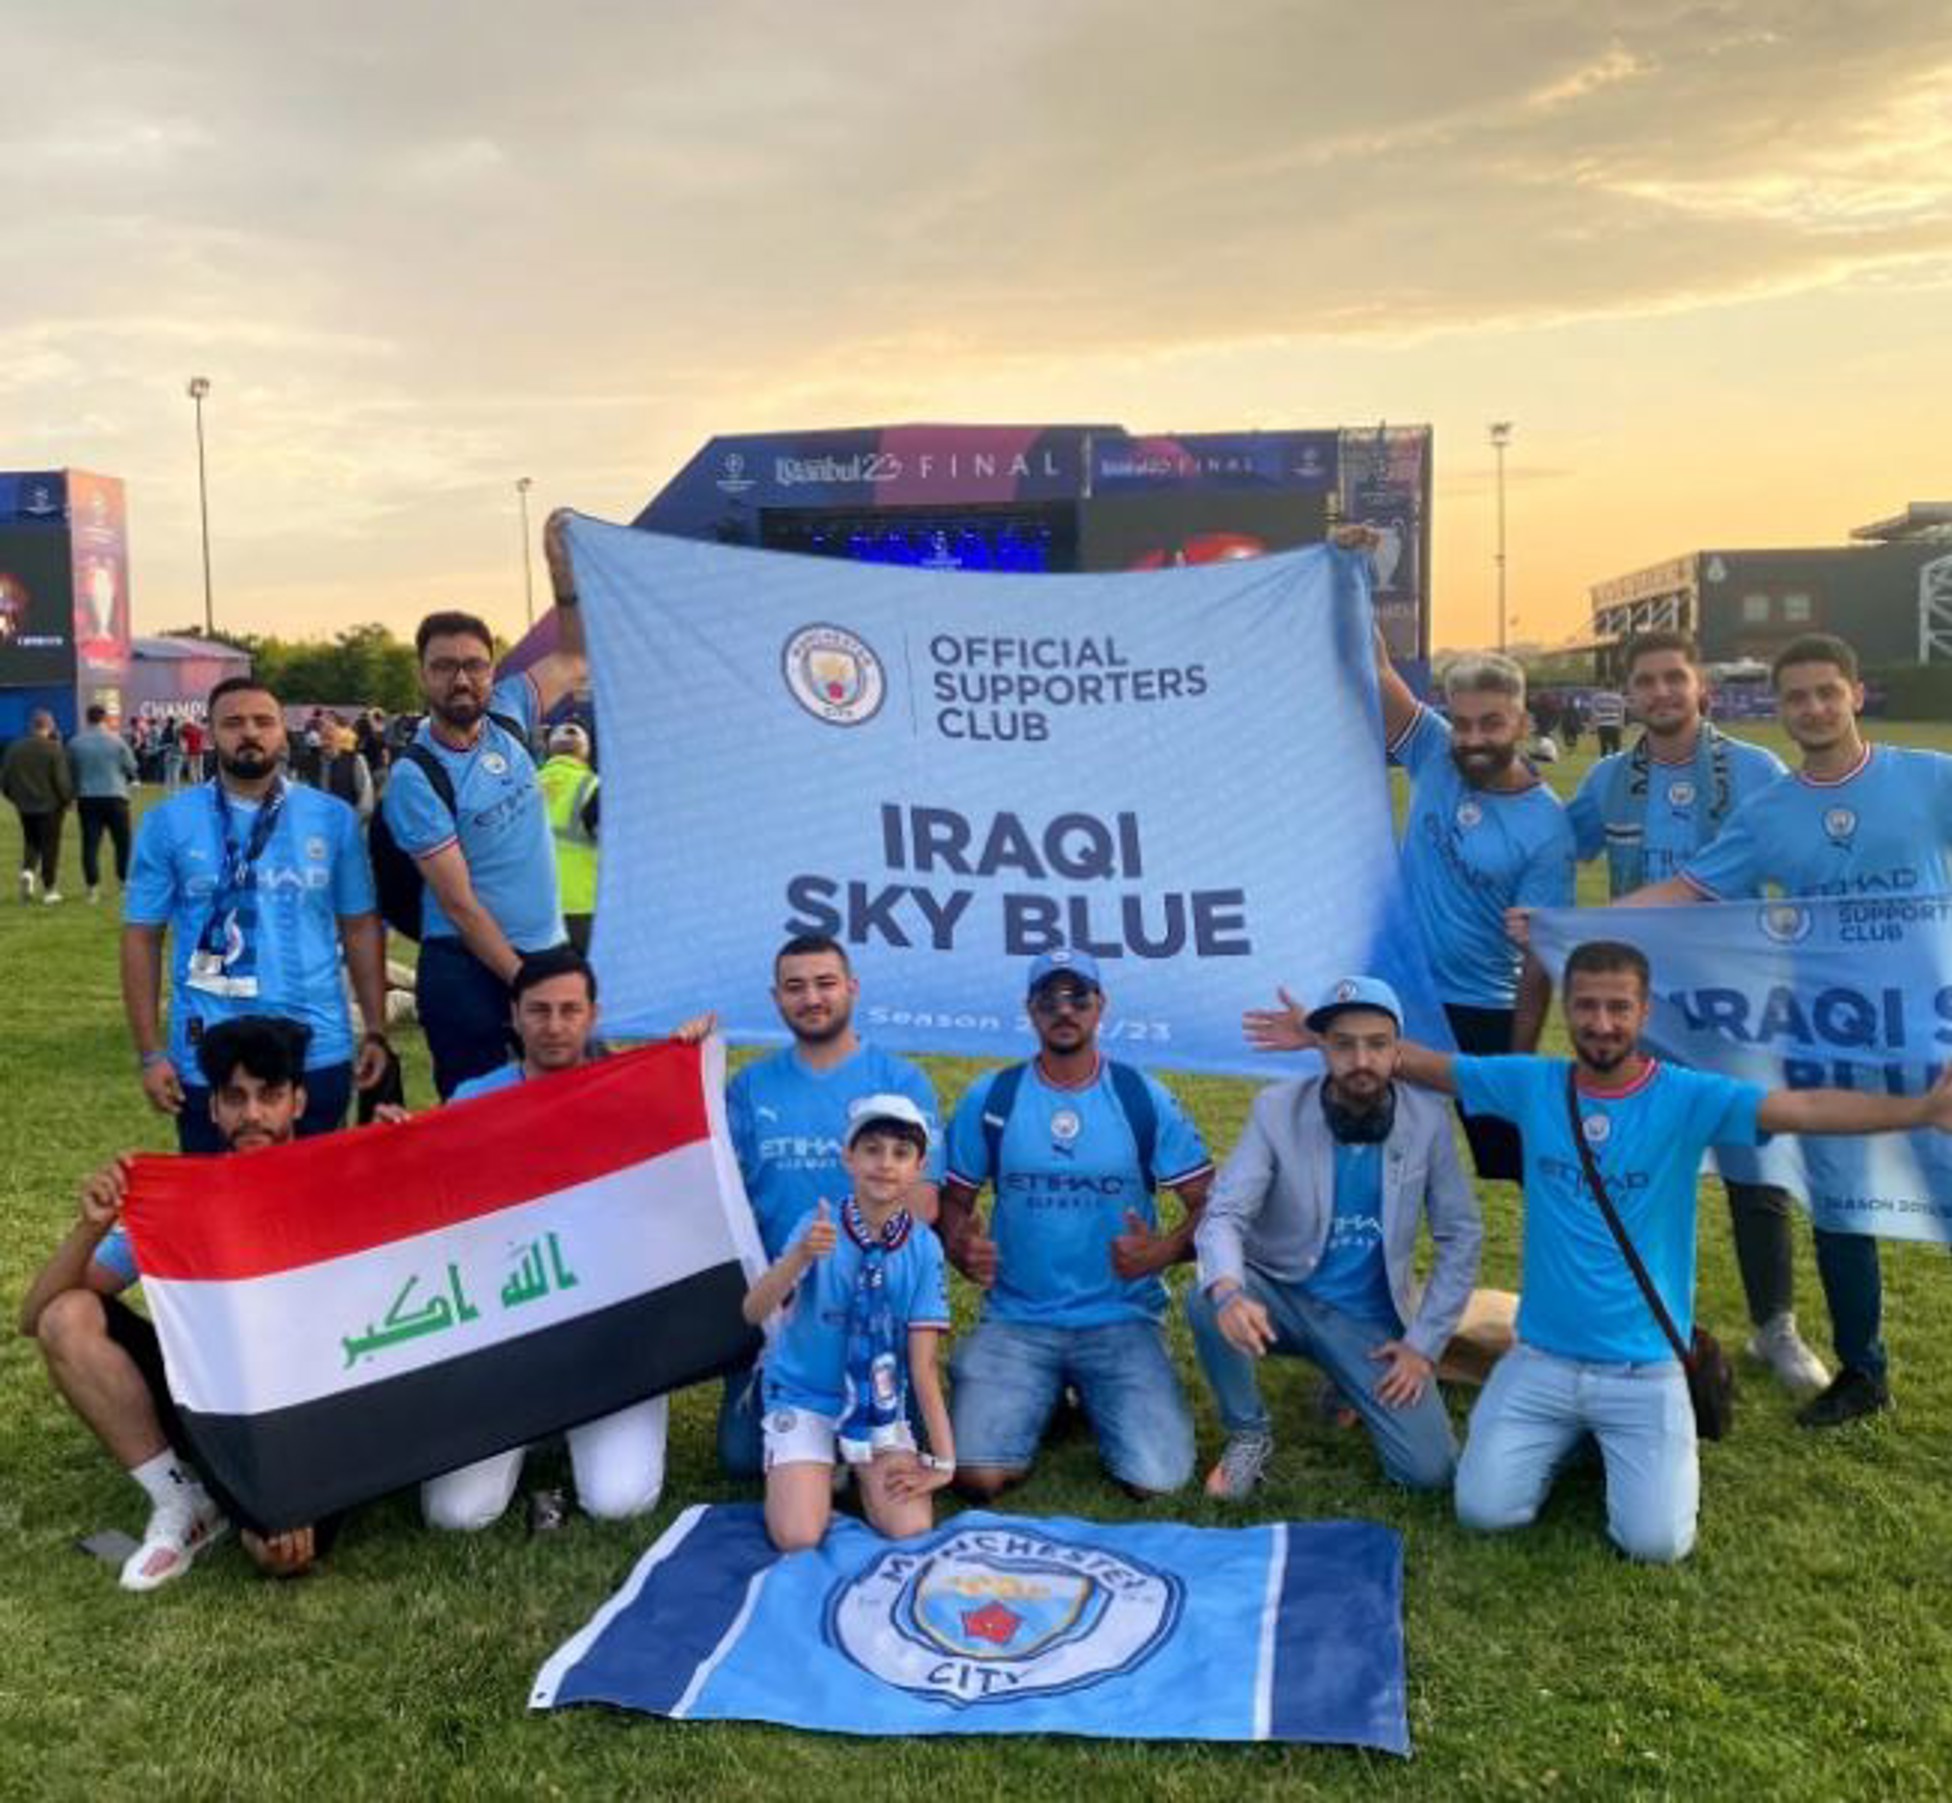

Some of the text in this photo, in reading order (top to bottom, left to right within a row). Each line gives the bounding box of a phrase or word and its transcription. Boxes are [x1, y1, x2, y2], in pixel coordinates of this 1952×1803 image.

[920, 452, 1060, 479] FINAL
[930, 634, 1129, 668] OFFICIAL
[933, 664, 1208, 706] SUPPORTERS
[937, 707, 1050, 741] CLUB
[881, 803, 1144, 881] IRAQI
[784, 874, 1252, 959] SKY BLUE
[1840, 924, 1903, 941] CLUB
[868, 1005, 1000, 1030] Season
[760, 1136, 843, 1160] ETIHA
[927, 1661, 1028, 1695] CITY
